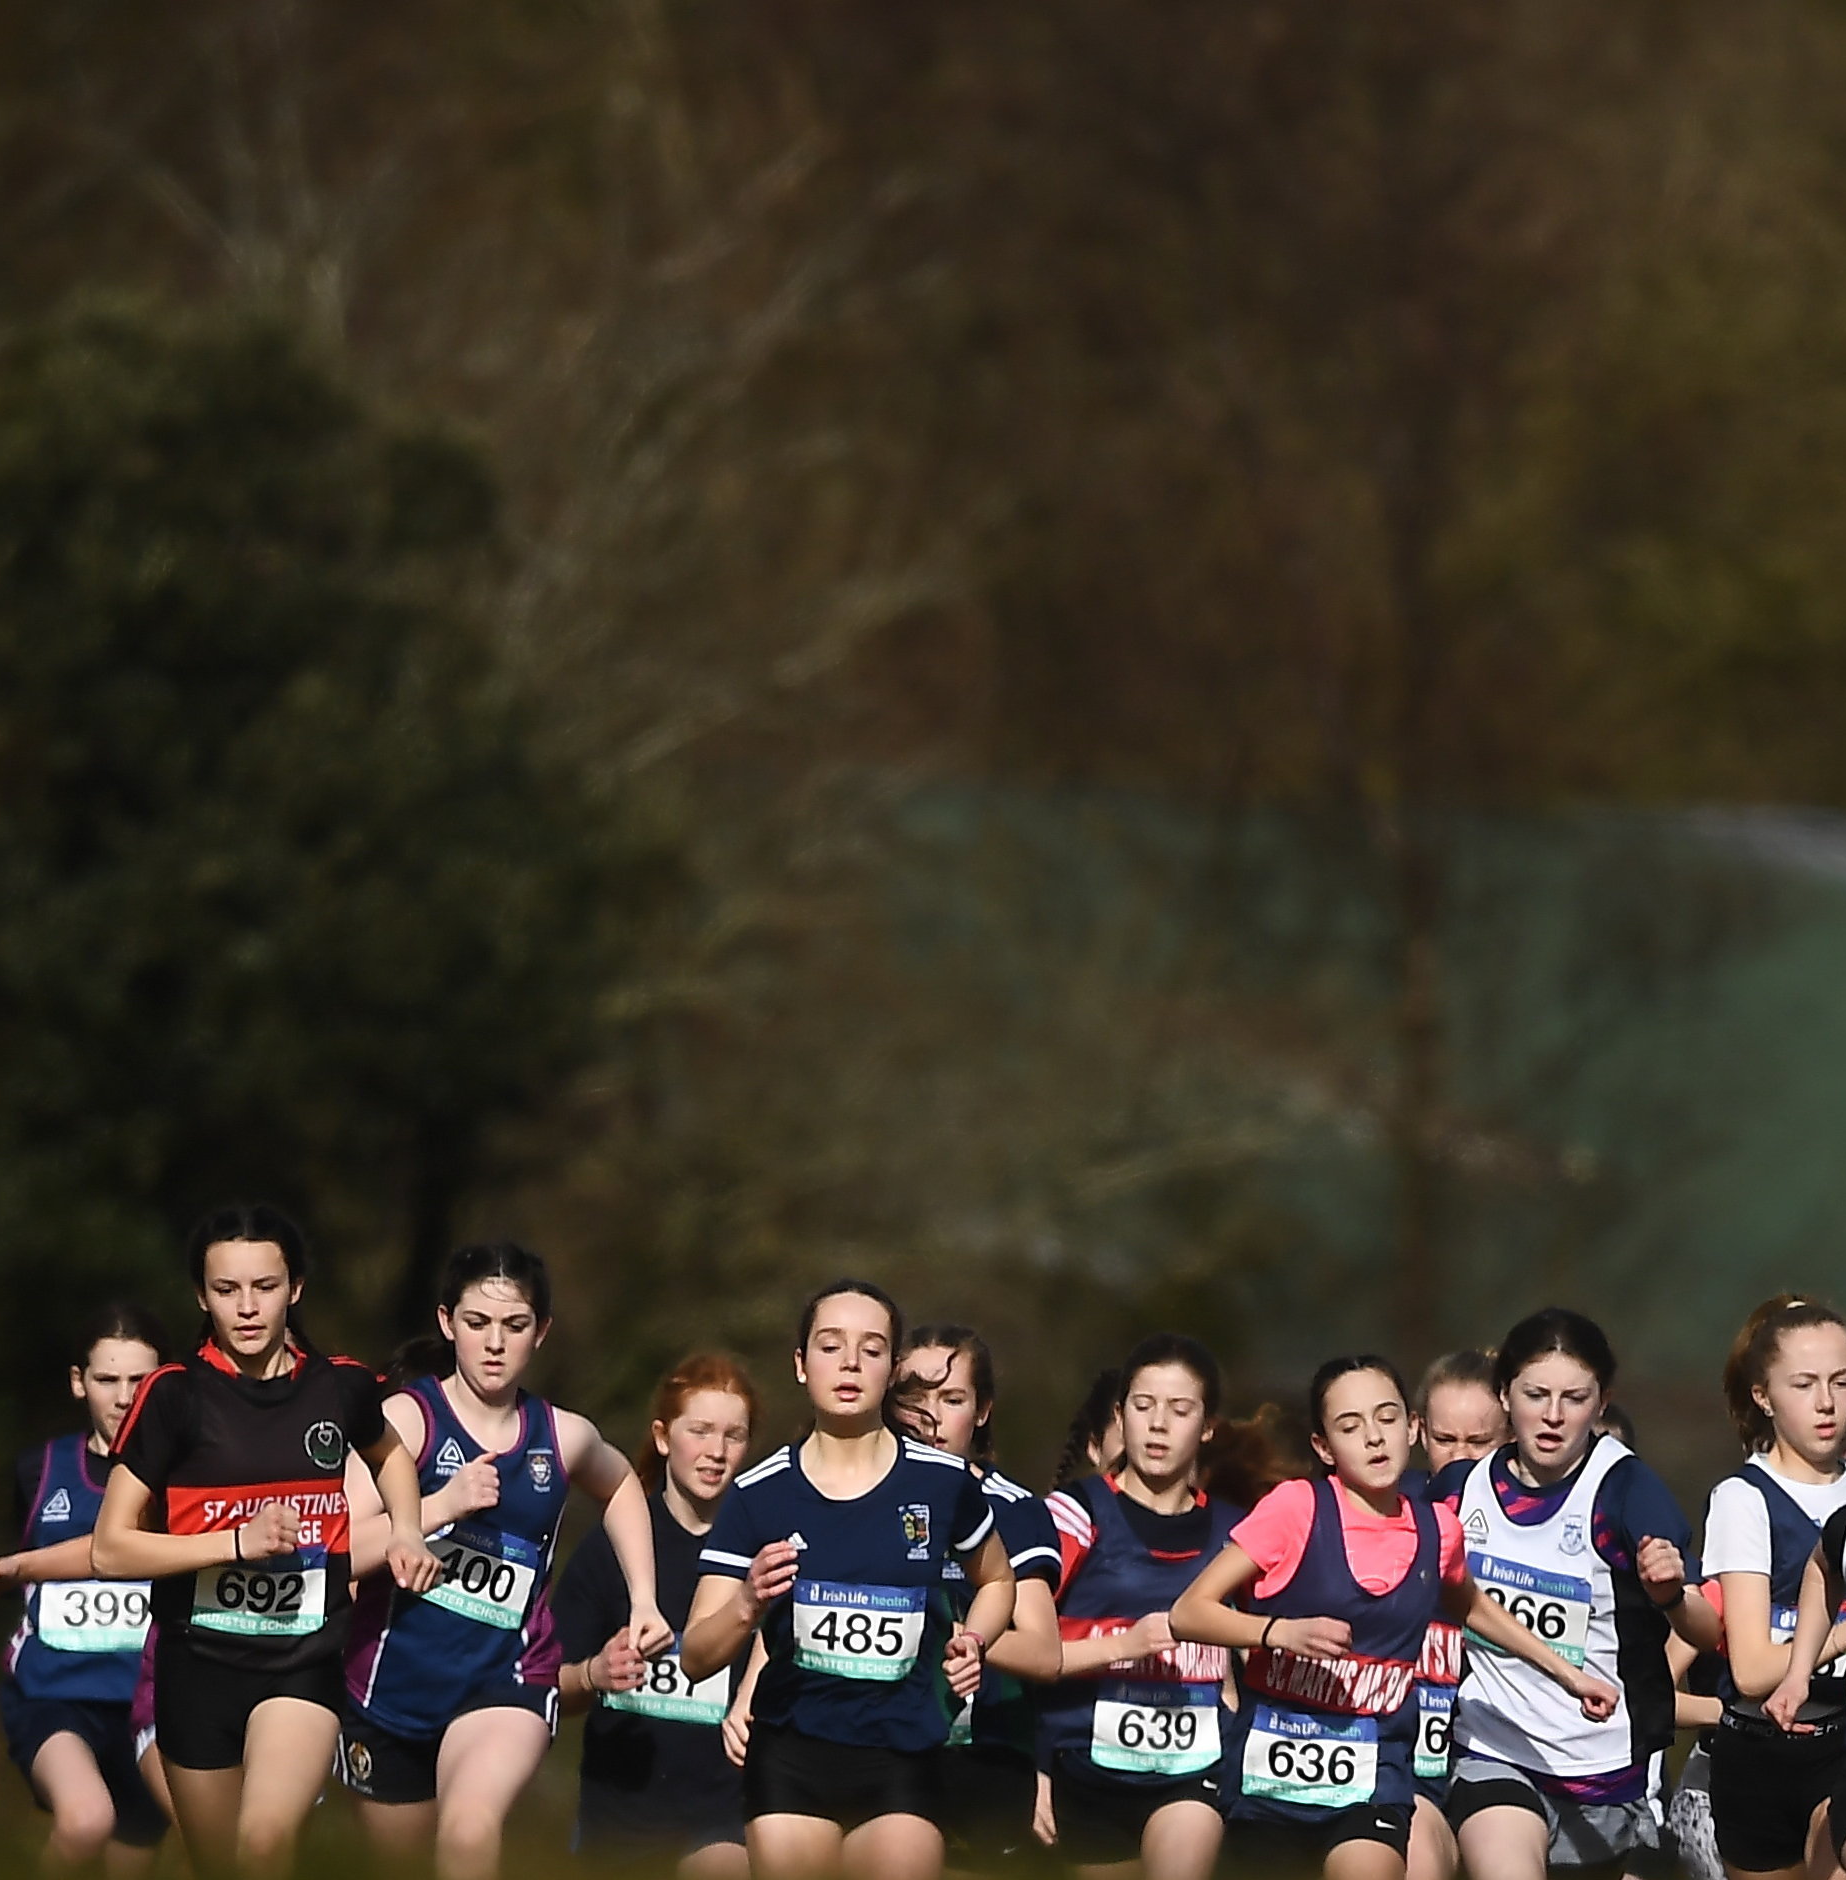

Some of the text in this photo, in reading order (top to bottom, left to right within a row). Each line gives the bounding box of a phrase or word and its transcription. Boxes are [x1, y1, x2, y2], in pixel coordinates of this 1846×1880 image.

[203, 1500, 226, 1523] ST
[216, 1569, 305, 1614] 692
[441, 1547, 516, 1603] 400
[1492, 1564, 1575, 1597] Irish Life health
[63, 1590, 150, 1628] 399
[822, 1589, 911, 1608] Irish Life health
[197, 1612, 257, 1630] MUNSTER
[811, 1611, 904, 1657] 485
[1118, 1709, 1197, 1751] 639
[1279, 1720, 1301, 1735] Irish
[1301, 1722, 1322, 1736] Life
[1268, 1740, 1356, 1786] 636
